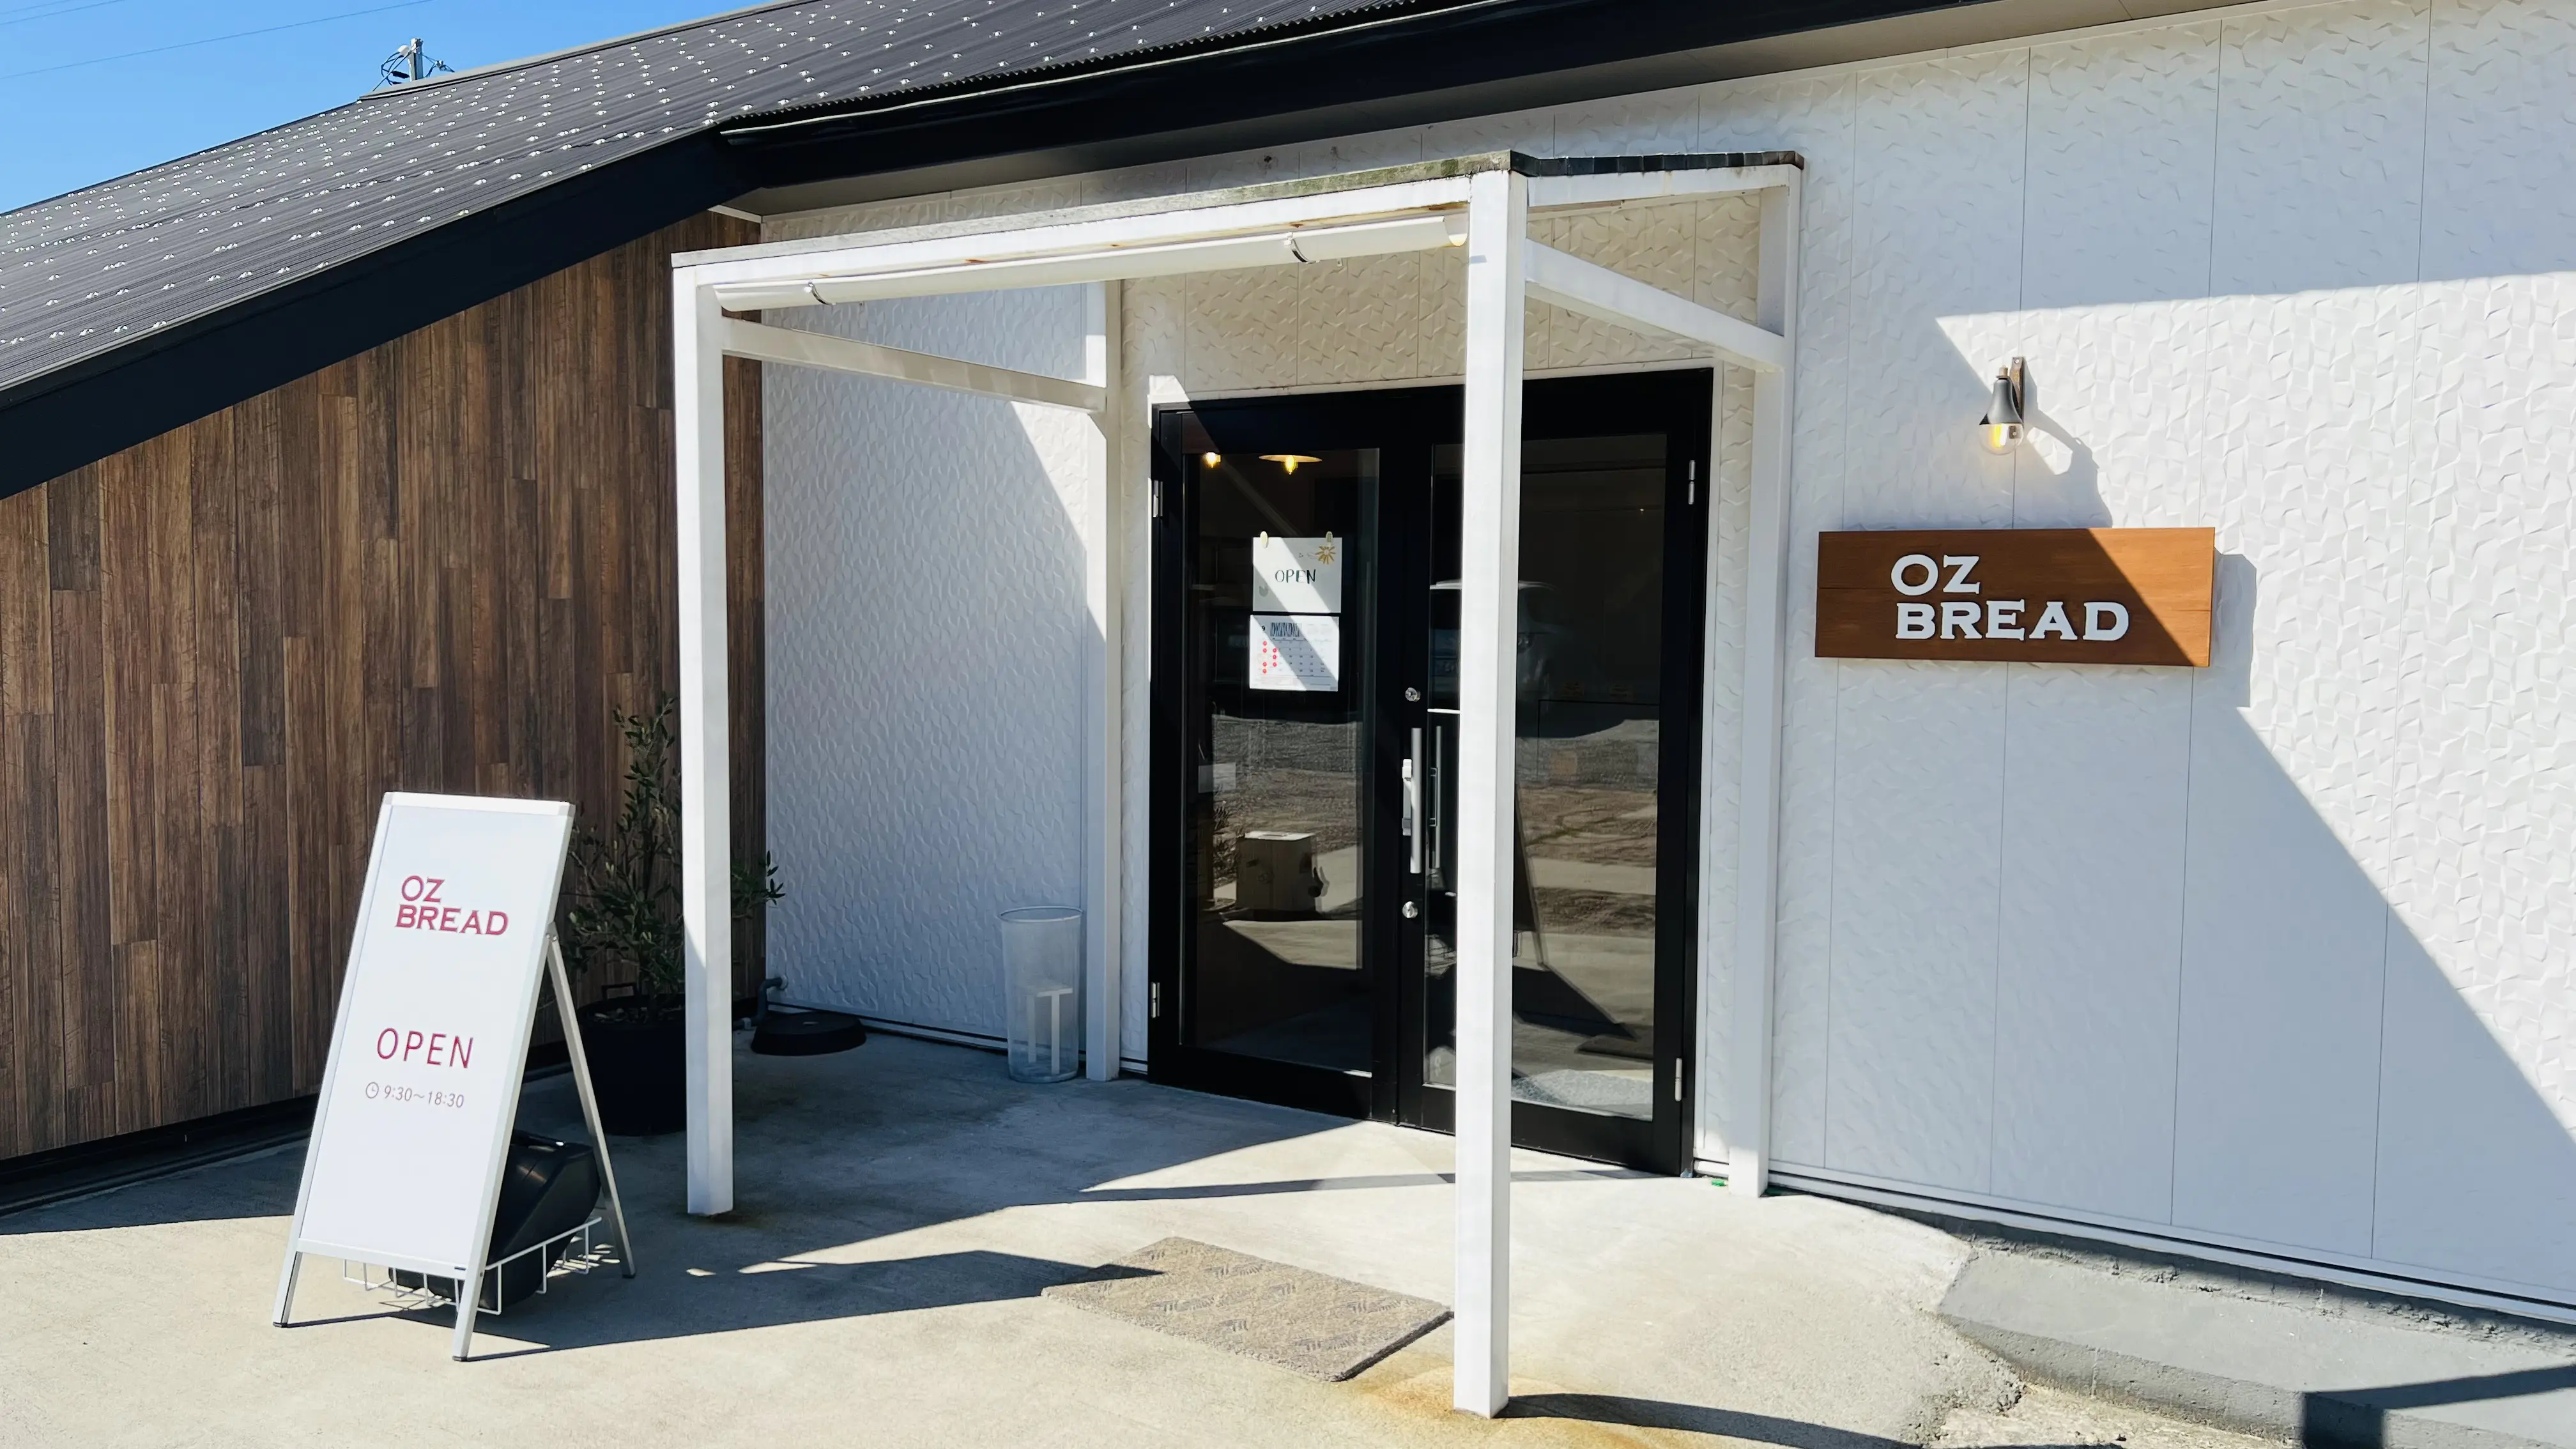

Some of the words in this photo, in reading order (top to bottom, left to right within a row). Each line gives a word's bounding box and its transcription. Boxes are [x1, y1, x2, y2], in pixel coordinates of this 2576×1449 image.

[1275, 569, 1316, 585] OPEN
[1890, 554, 1981, 596] OZ
[1895, 599, 2129, 641] BREAD
[401, 875, 445, 903] OZ
[395, 904, 509, 935] BREAD
[376, 1027, 474, 1069] OPEN
